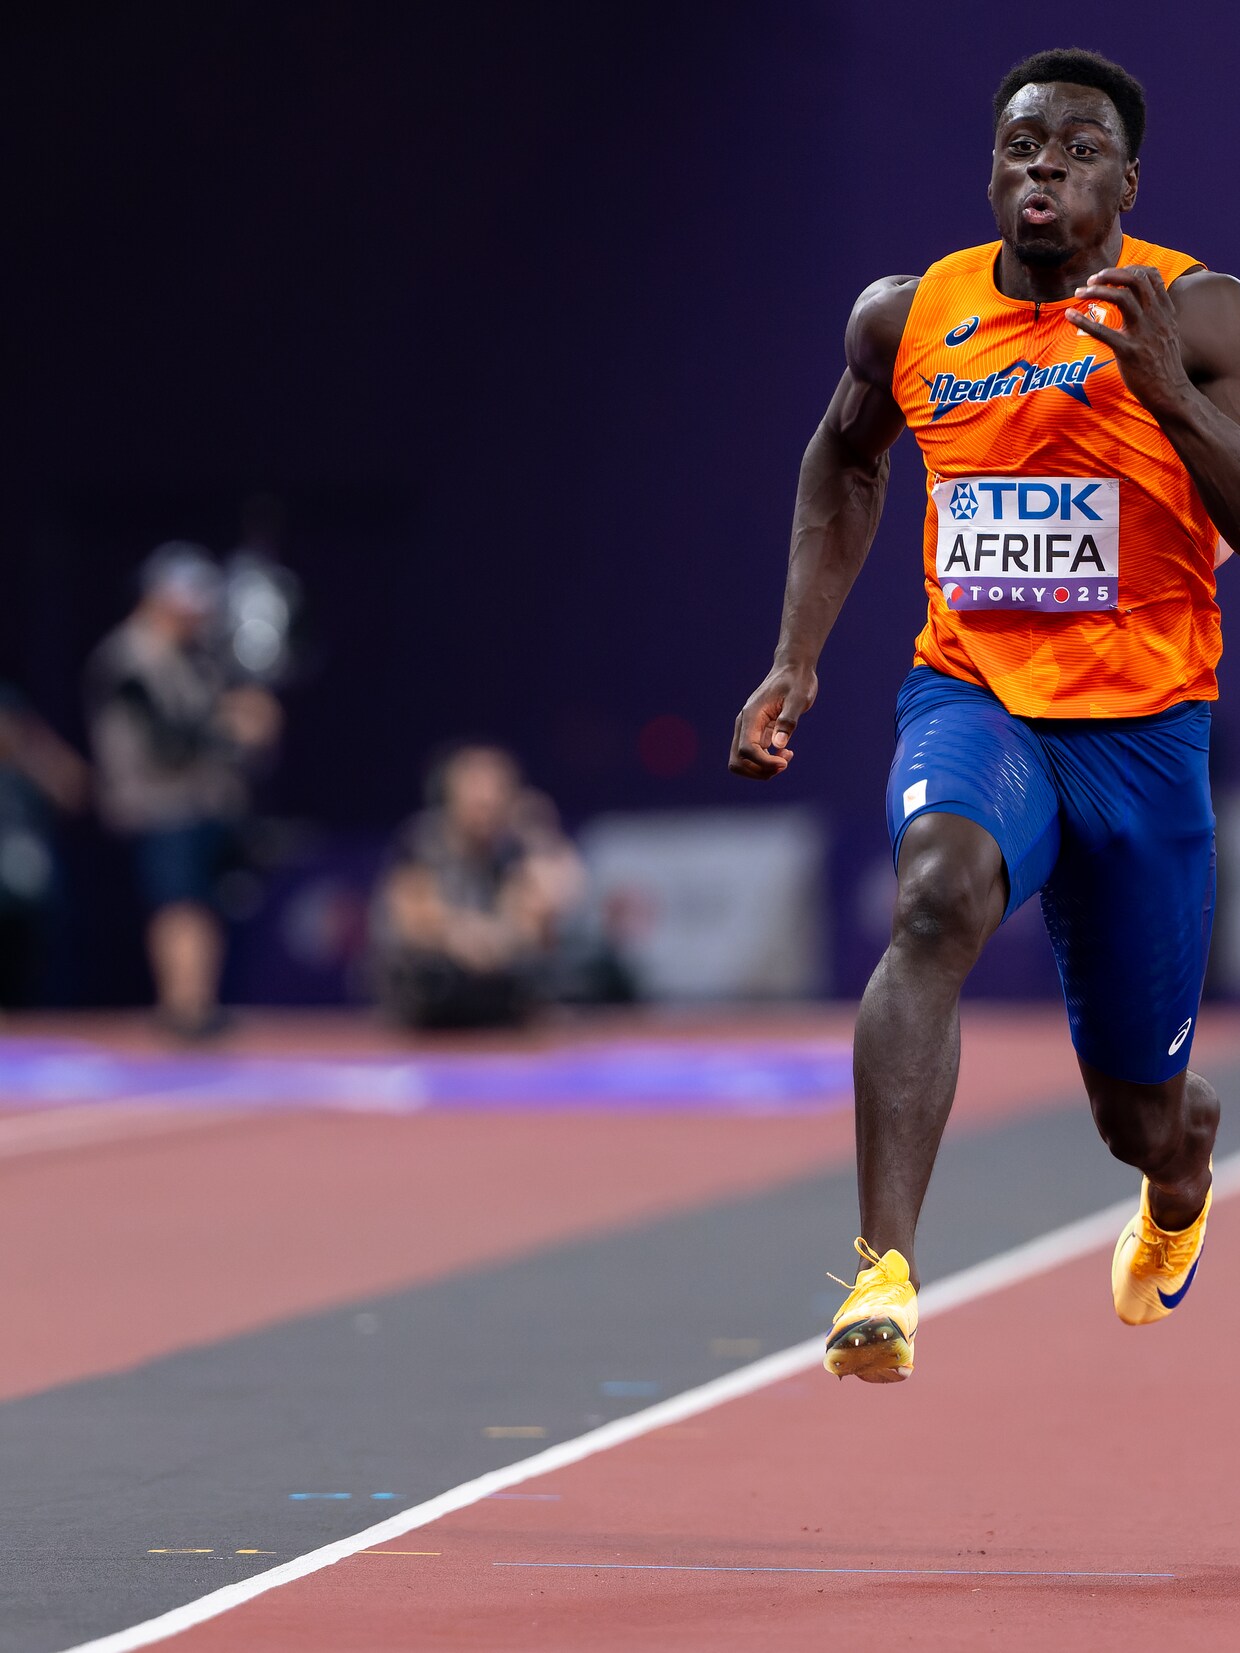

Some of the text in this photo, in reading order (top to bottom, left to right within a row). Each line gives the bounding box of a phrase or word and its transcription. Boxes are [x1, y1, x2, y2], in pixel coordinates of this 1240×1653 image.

[928, 355, 1095, 403] Nederland
[978, 482, 1103, 520] TDK
[944, 534, 1105, 572] AFRIFA
